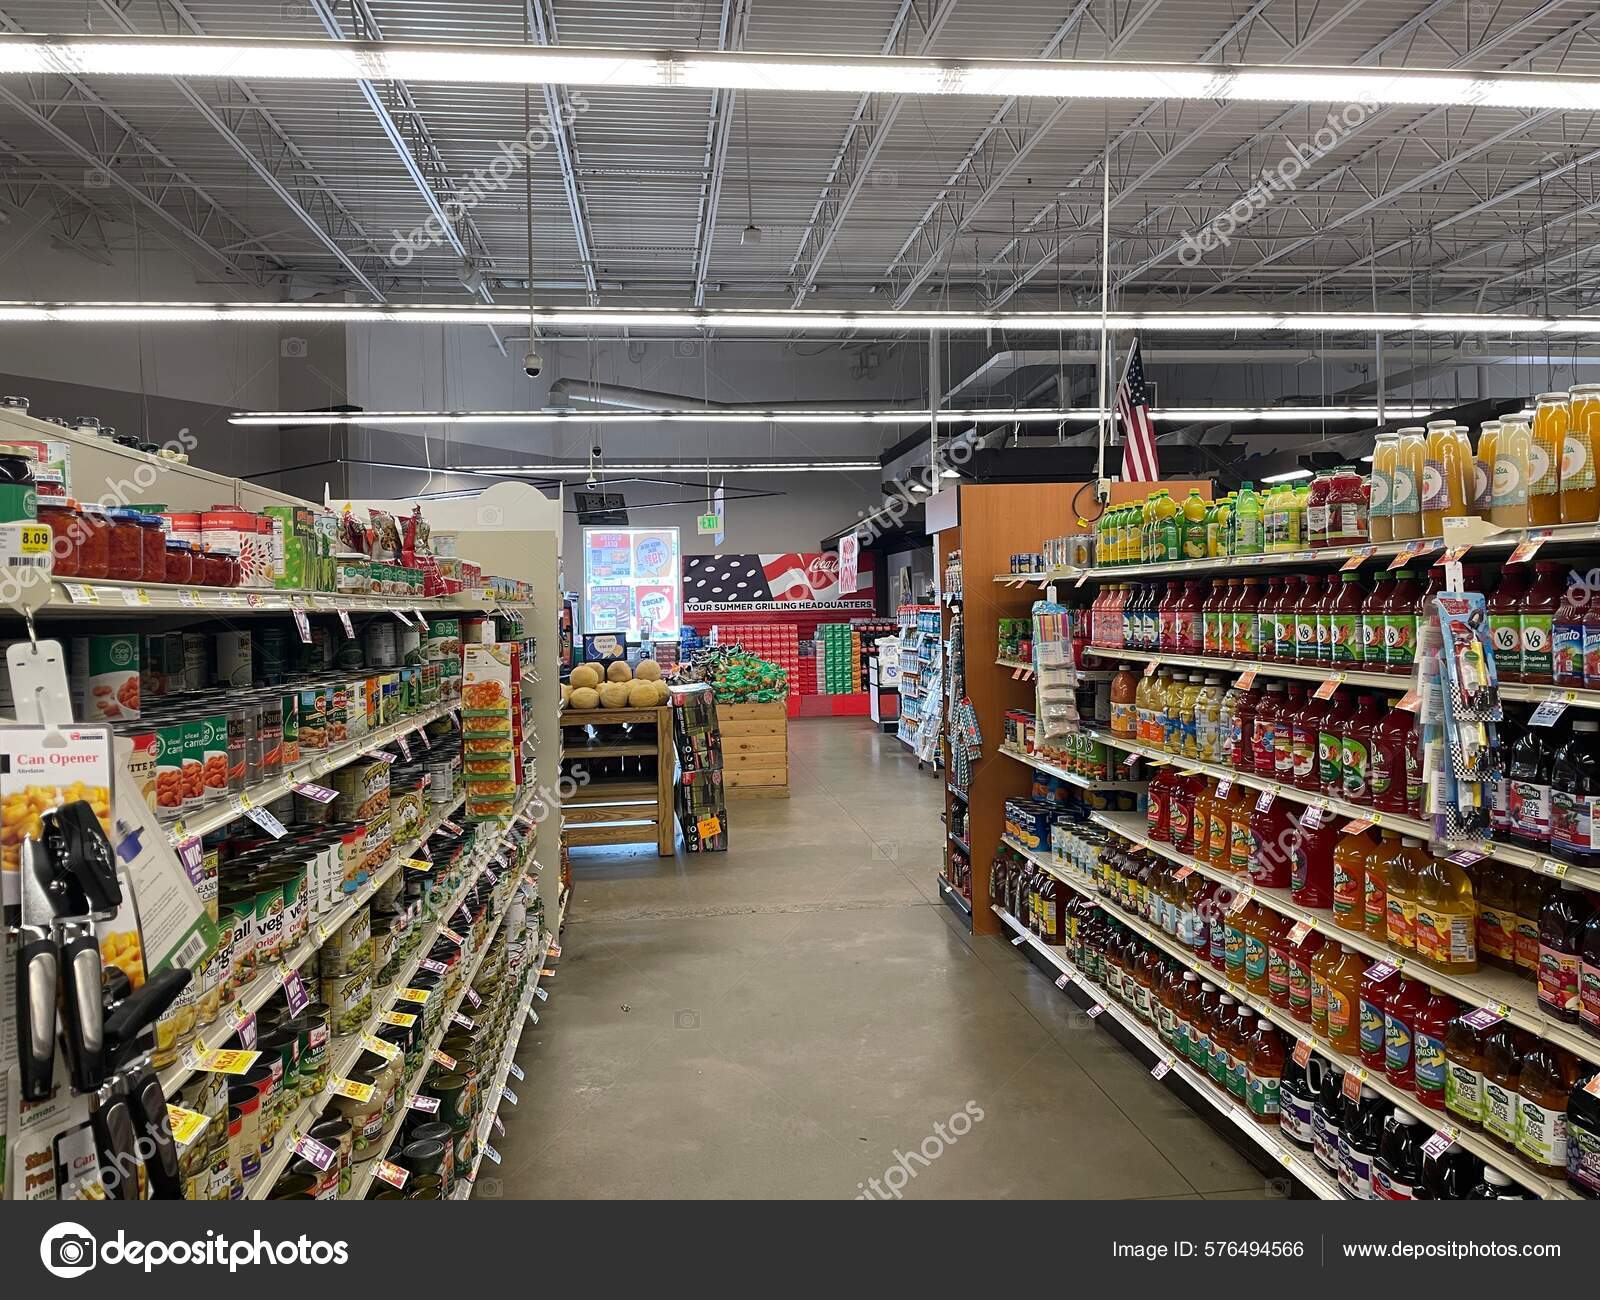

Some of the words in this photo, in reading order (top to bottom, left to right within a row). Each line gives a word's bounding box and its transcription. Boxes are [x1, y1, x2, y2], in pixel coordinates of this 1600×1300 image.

[701, 516, 718, 529] EXIT
[22, 533, 48, 544] 8.09
[686, 604, 713, 612] YOUR
[714, 603, 753, 611] SUMMER
[755, 602, 797, 610] GRILLING
[798, 600, 872, 609] HEADQUARTERS
[1497, 630, 1513, 647] V8
[1526, 630, 1541, 648] V8
[1538, 707, 1560, 717] 2.99
[17, 754, 45, 766] Can
[50, 753, 99, 767] Opener
[234, 920, 251, 942] all
[20, 1103, 56, 1127] Lemon
[73, 1152, 96, 1169] Can
